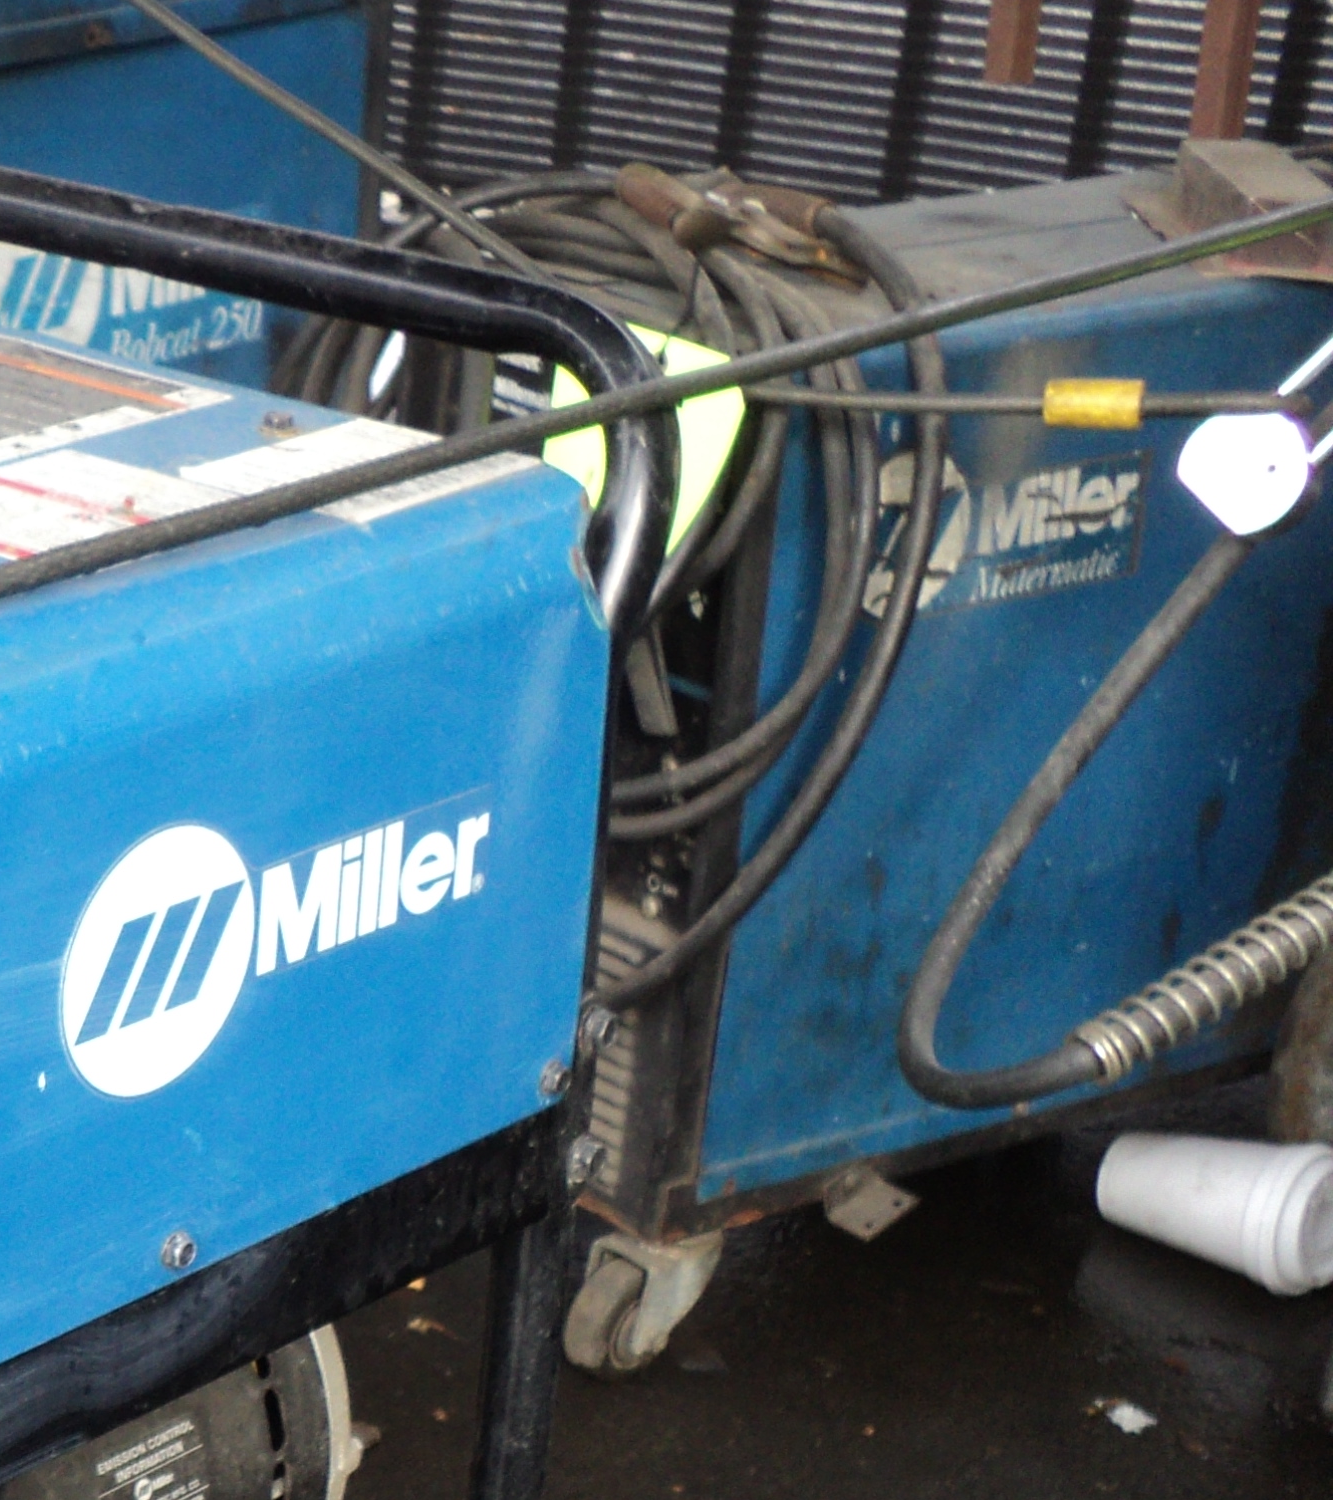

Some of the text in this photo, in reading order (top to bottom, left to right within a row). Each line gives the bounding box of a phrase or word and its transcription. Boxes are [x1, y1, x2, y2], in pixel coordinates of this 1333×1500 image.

[207, 300, 263, 349] 250
[978, 466, 1140, 554] Miller
[256, 812, 490, 976] Miller
